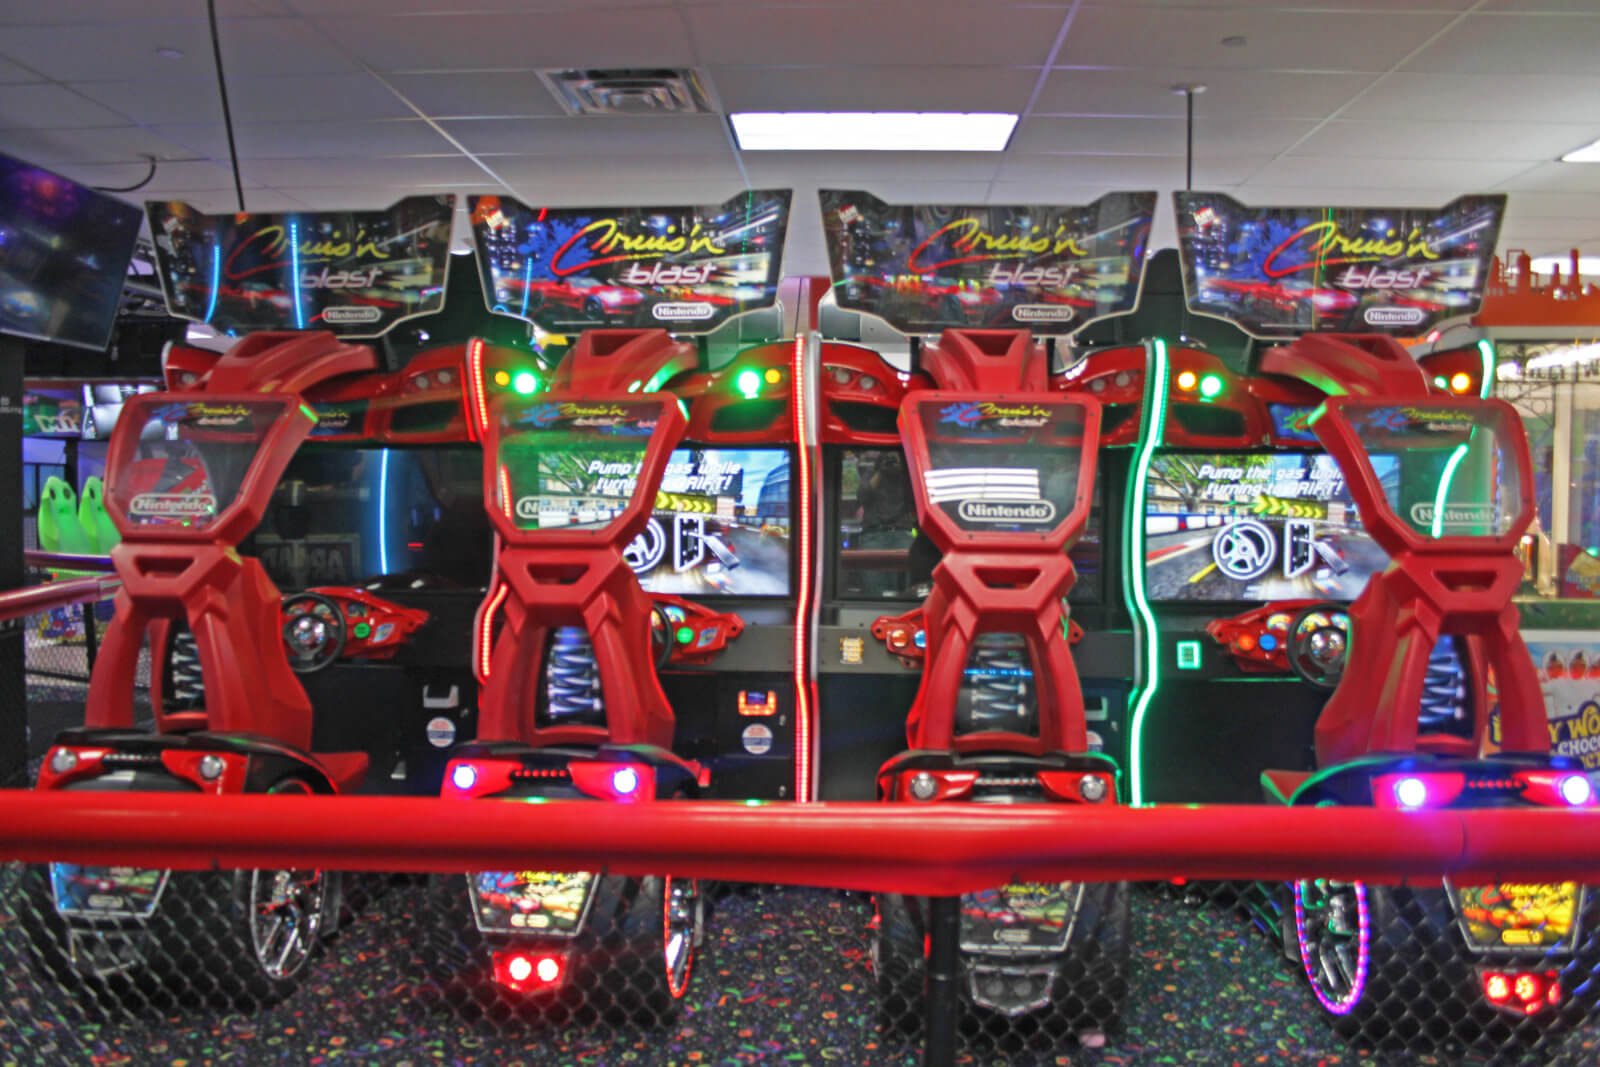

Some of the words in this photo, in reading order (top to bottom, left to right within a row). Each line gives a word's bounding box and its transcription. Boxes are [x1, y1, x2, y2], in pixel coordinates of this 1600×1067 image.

[550, 219, 725, 276] Cruis'n
[908, 218, 1088, 274] Cruis'n
[1263, 221, 1439, 278] Cruis'n
[299, 267, 385, 289] blast
[627, 262, 717, 285] blast
[989, 263, 1080, 286] blast
[1342, 266, 1431, 289] blast
[327, 310, 377, 320] Nintendo
[657, 306, 708, 317] Nintendo
[1018, 308, 1069, 319] Nintendo
[1369, 311, 1419, 322] Nintendo
[588, 460, 632, 475] Pump
[1198, 464, 1243, 480] Pump
[1246, 465, 1272, 480] the
[1275, 467, 1305, 480] gas
[967, 503, 1048, 518] Nintendo
